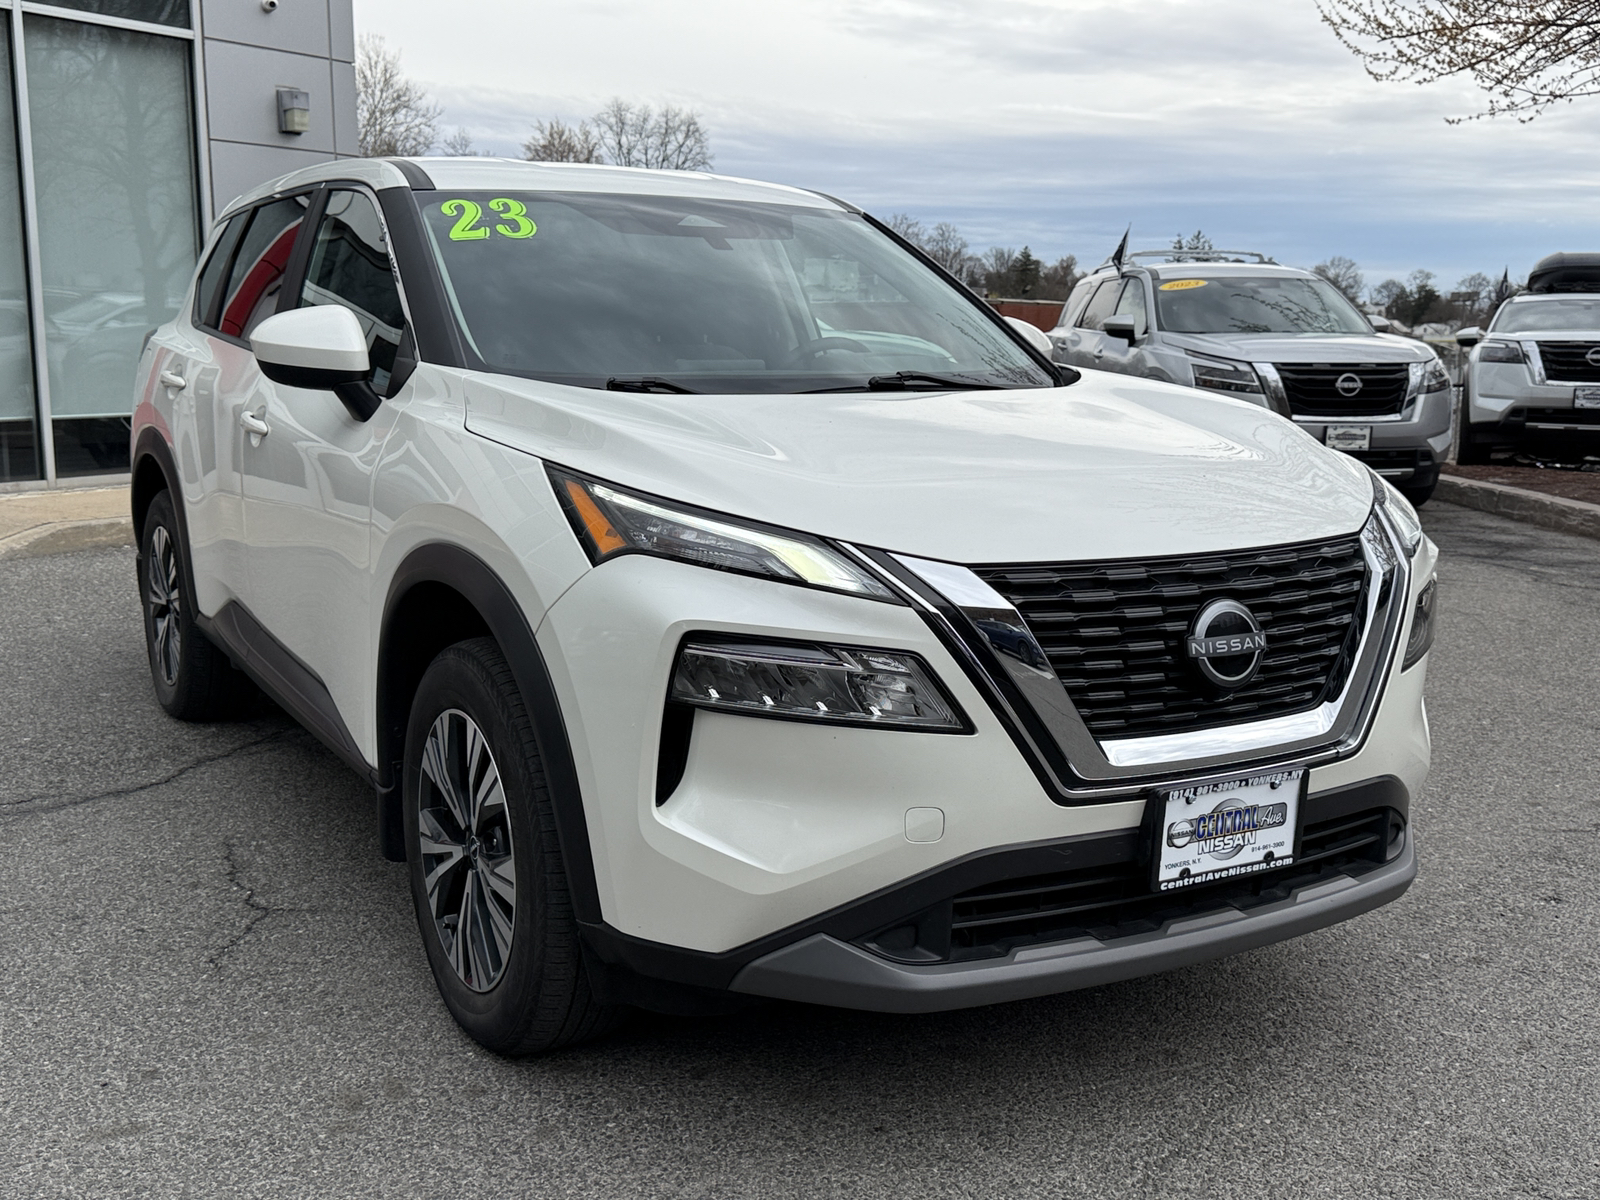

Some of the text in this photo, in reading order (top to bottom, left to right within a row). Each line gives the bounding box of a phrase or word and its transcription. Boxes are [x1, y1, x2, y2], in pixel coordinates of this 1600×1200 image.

[441, 199, 537, 240] 23
[1191, 635, 1265, 655] NISSAN
[1170, 829, 1194, 838] NISSAN
[1196, 805, 1259, 839] CENTRAL
[1198, 831, 1256, 855] NISSAN
